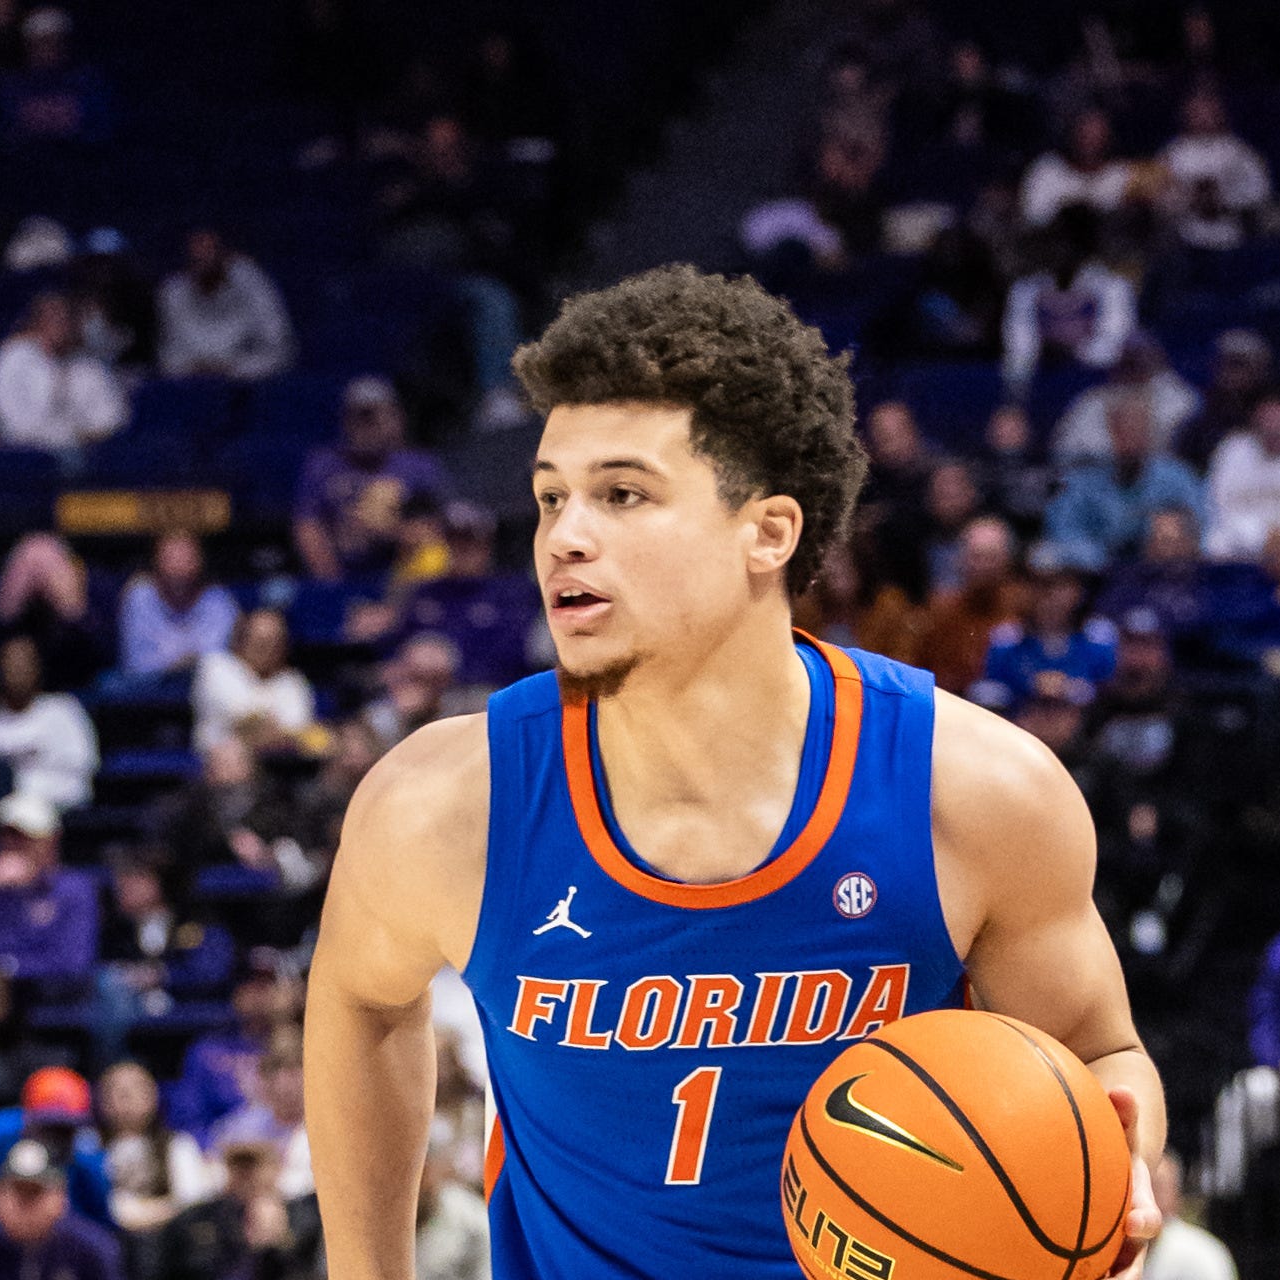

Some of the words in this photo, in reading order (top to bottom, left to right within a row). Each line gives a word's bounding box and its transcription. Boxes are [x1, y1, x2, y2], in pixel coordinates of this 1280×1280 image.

[836, 875, 874, 915] SEC
[507, 963, 912, 1051] FLORIDA
[665, 1066, 722, 1185] 1
